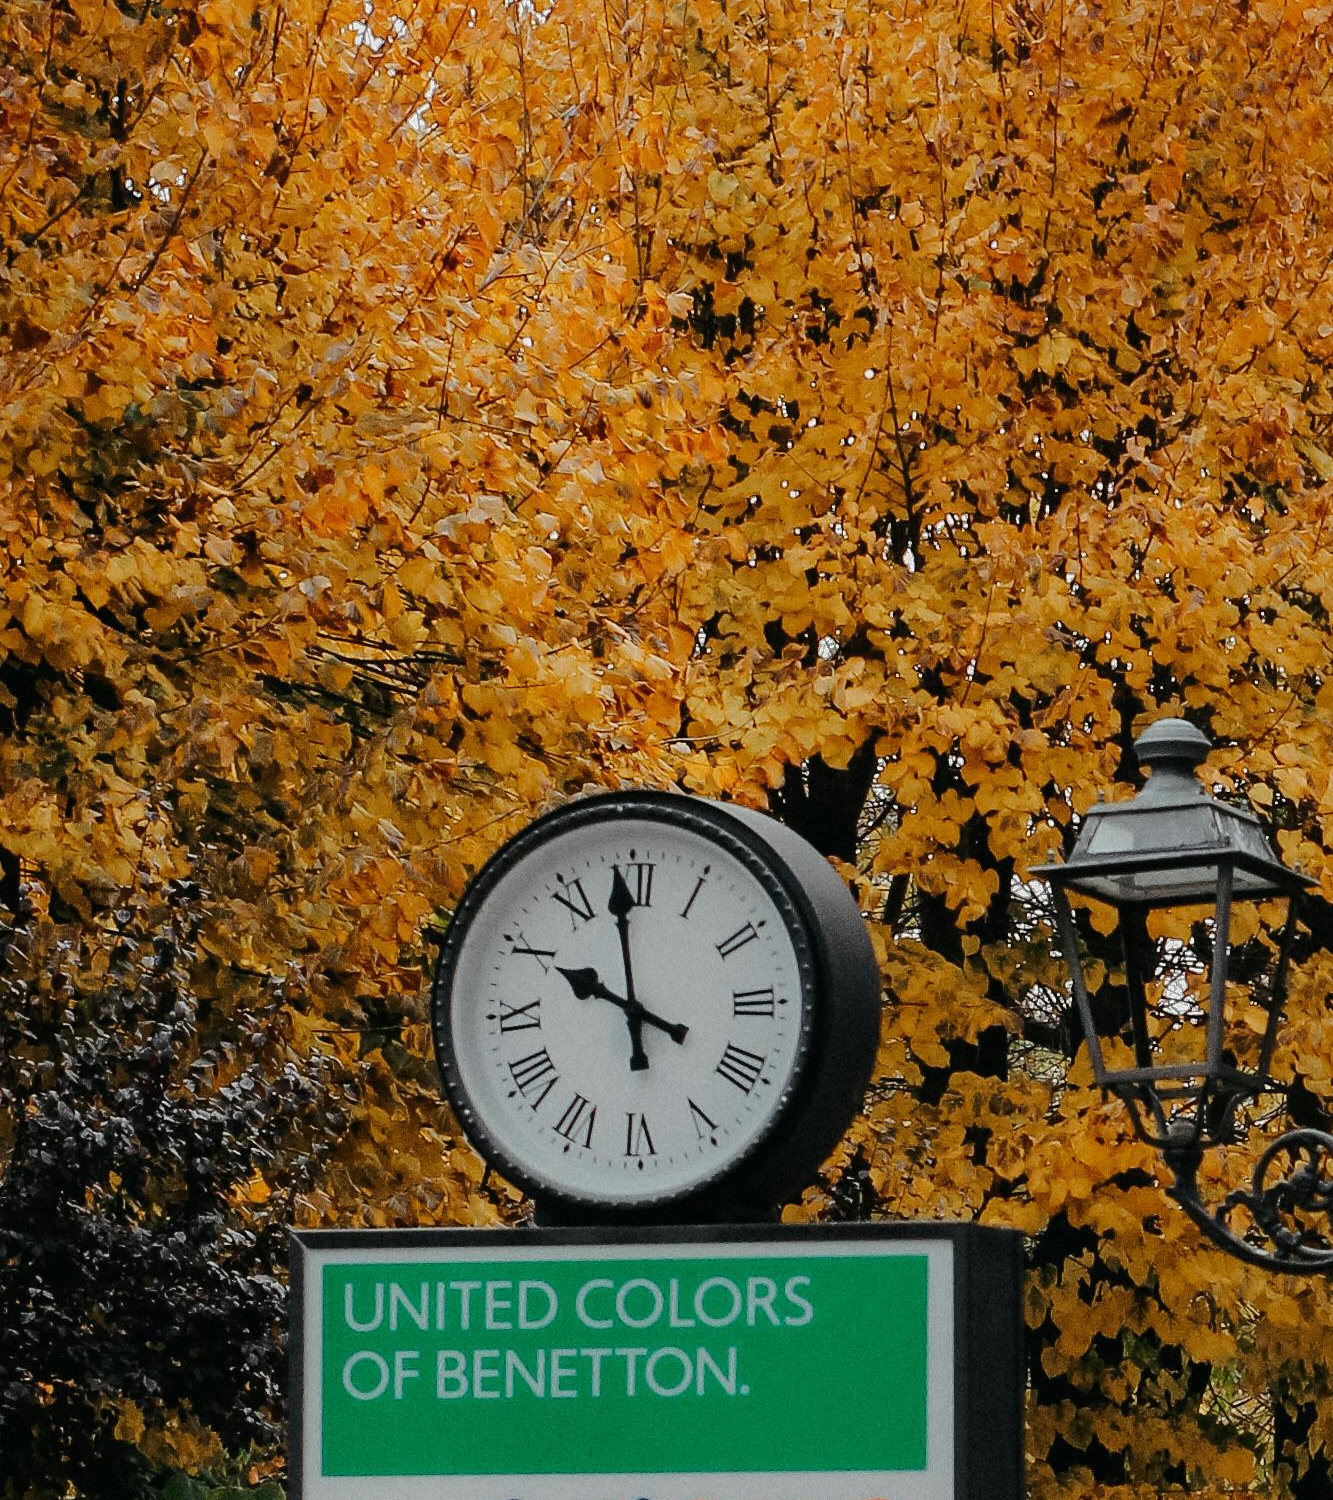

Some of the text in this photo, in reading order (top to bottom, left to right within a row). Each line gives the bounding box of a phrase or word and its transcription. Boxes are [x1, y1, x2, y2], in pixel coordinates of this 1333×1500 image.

[343, 1276, 814, 1333] UNITED COLORS
[342, 1347, 751, 1402] OF BENETTON.
